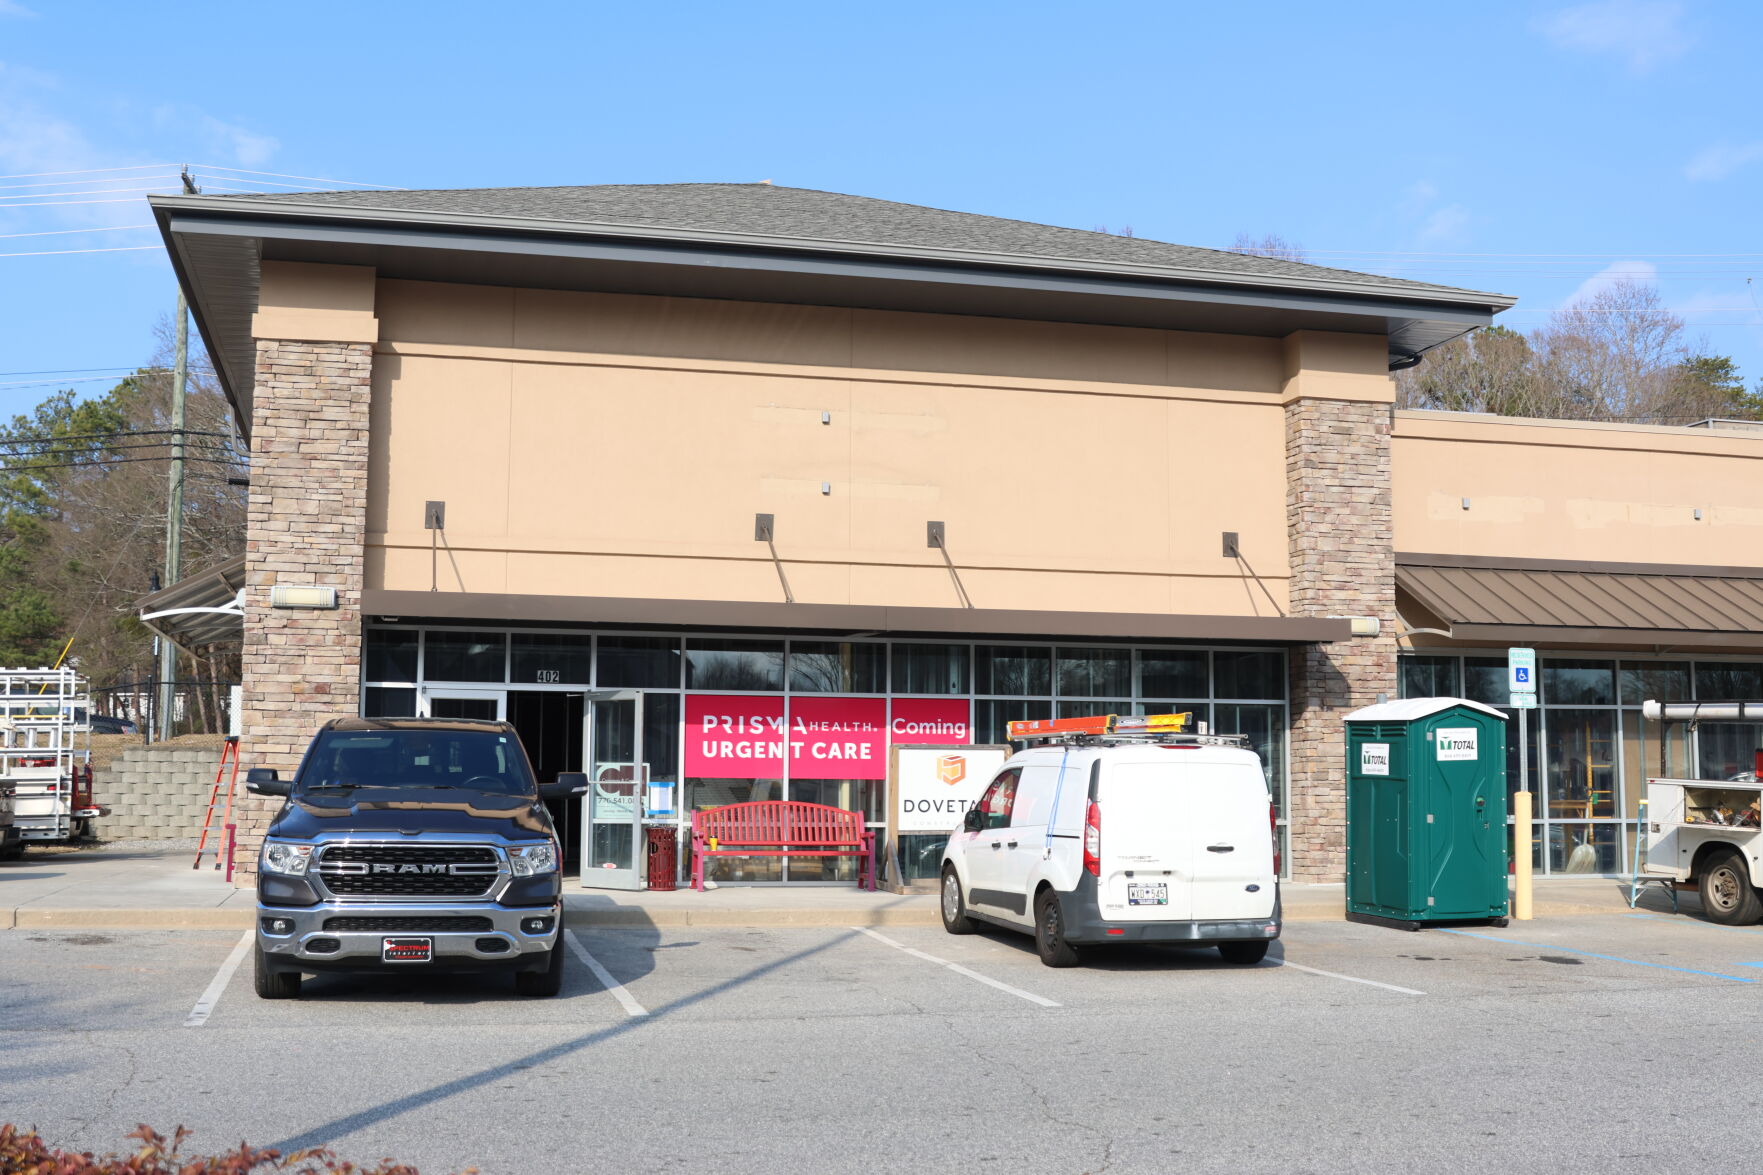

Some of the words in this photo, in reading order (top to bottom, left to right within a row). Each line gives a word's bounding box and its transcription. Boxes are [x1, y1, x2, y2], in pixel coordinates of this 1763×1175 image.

[538, 671, 559, 683] 402
[702, 715, 808, 735] PRISMA
[892, 718, 966, 739] Coming
[702, 740, 805, 759] URGENT
[811, 742, 872, 760] CARE
[1453, 740, 1475, 750] TOTAL
[1371, 755, 1387, 765] TOTAL
[373, 863, 447, 874] RAM
[1151, 888, 1165, 899] 545
